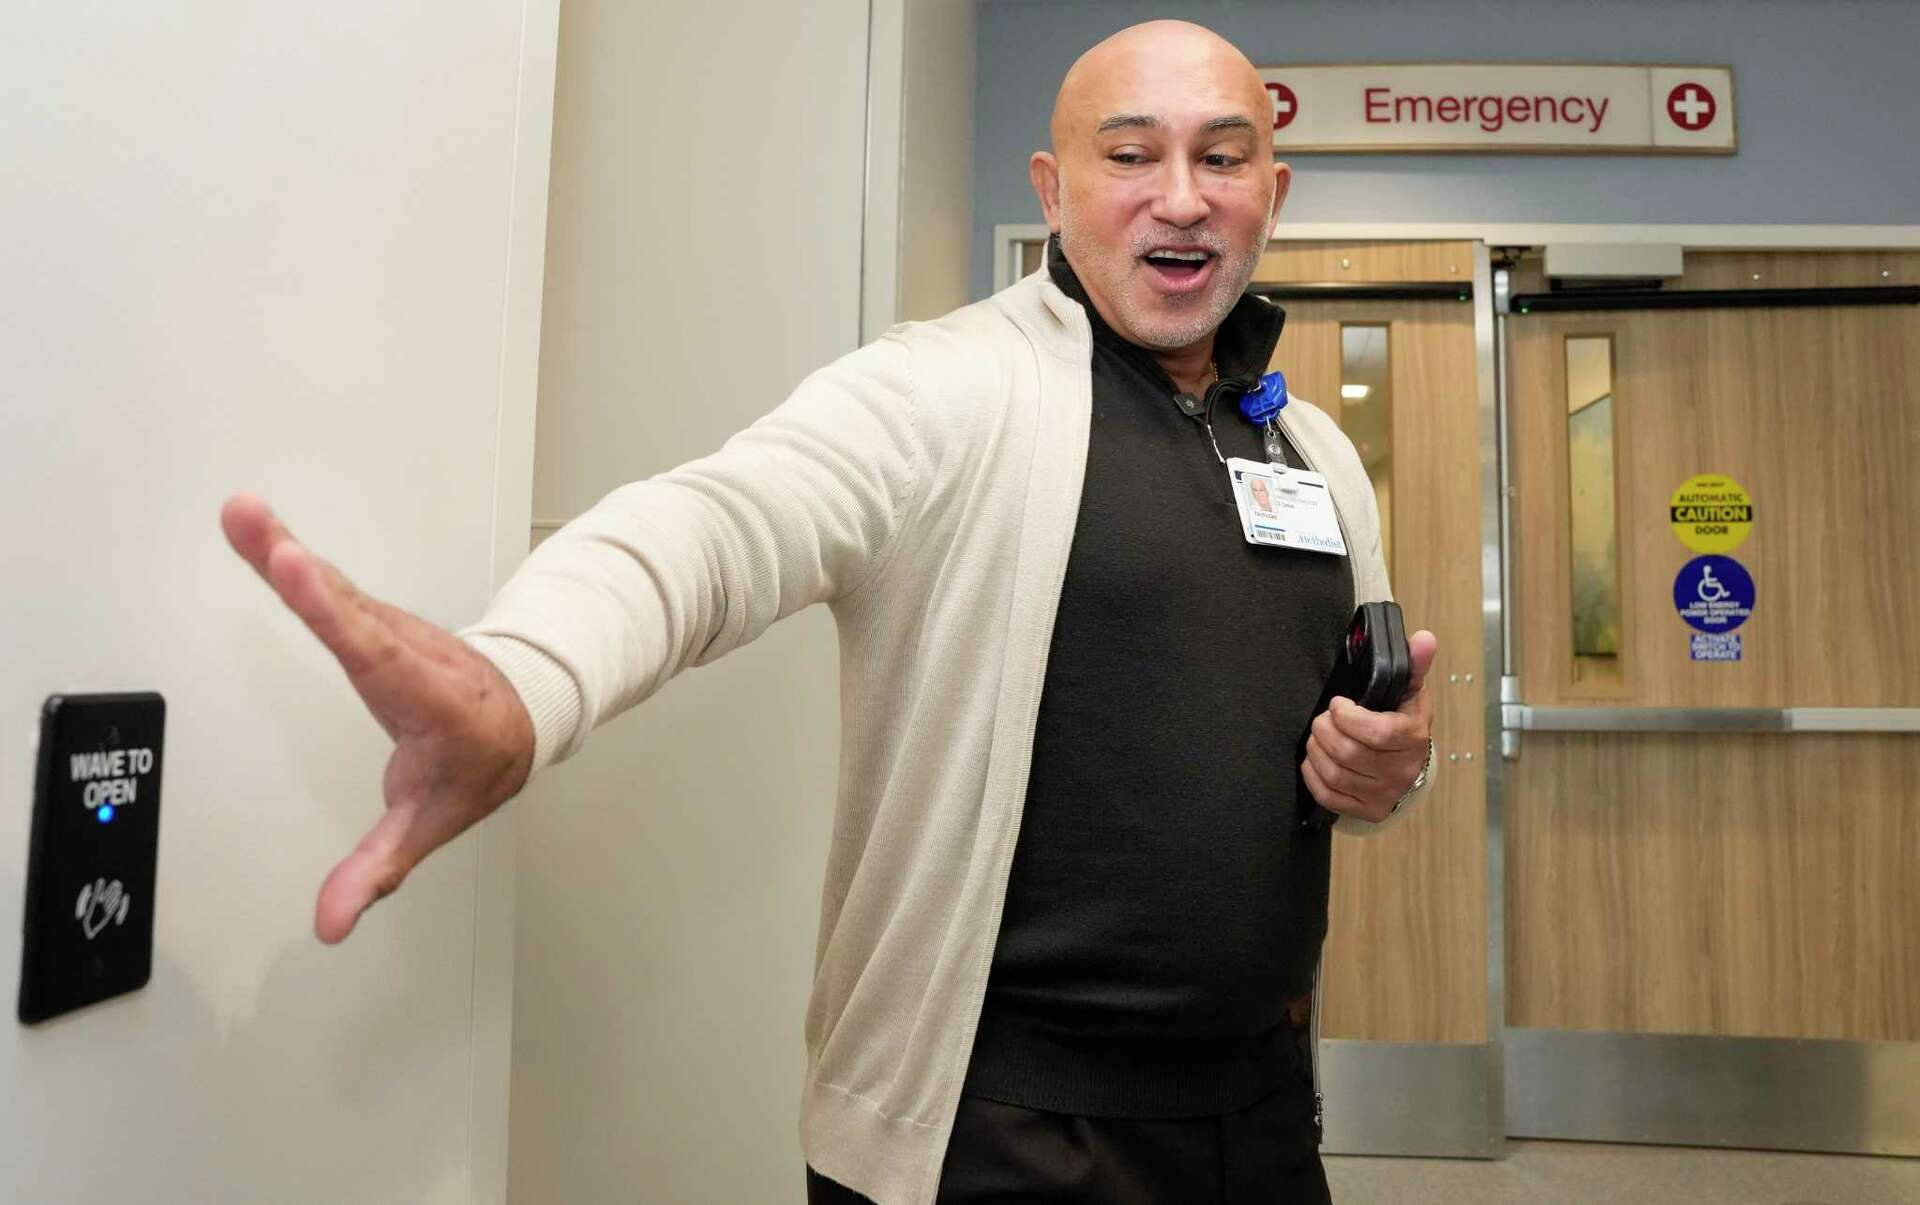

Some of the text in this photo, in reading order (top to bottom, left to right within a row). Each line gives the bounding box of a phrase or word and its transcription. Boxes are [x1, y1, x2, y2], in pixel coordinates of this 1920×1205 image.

[1364, 87, 1608, 131] Emergency
[1679, 494, 1743, 503] AUTOMATIC
[1675, 506, 1748, 521] CAUTION
[1695, 526, 1728, 535] DOOR
[1297, 534, 1343, 549] Methodist
[1689, 601, 1708, 609] LOW
[1680, 608, 1708, 617] POWER
[1703, 616, 1728, 624] DOOR
[1695, 633, 1737, 642] ACTIVATE
[1692, 641, 1740, 651] SWITCH TO
[1695, 650, 1737, 659] OPERATE
[70, 748, 153, 781] WAVE TO
[83, 778, 137, 809] OPEN
